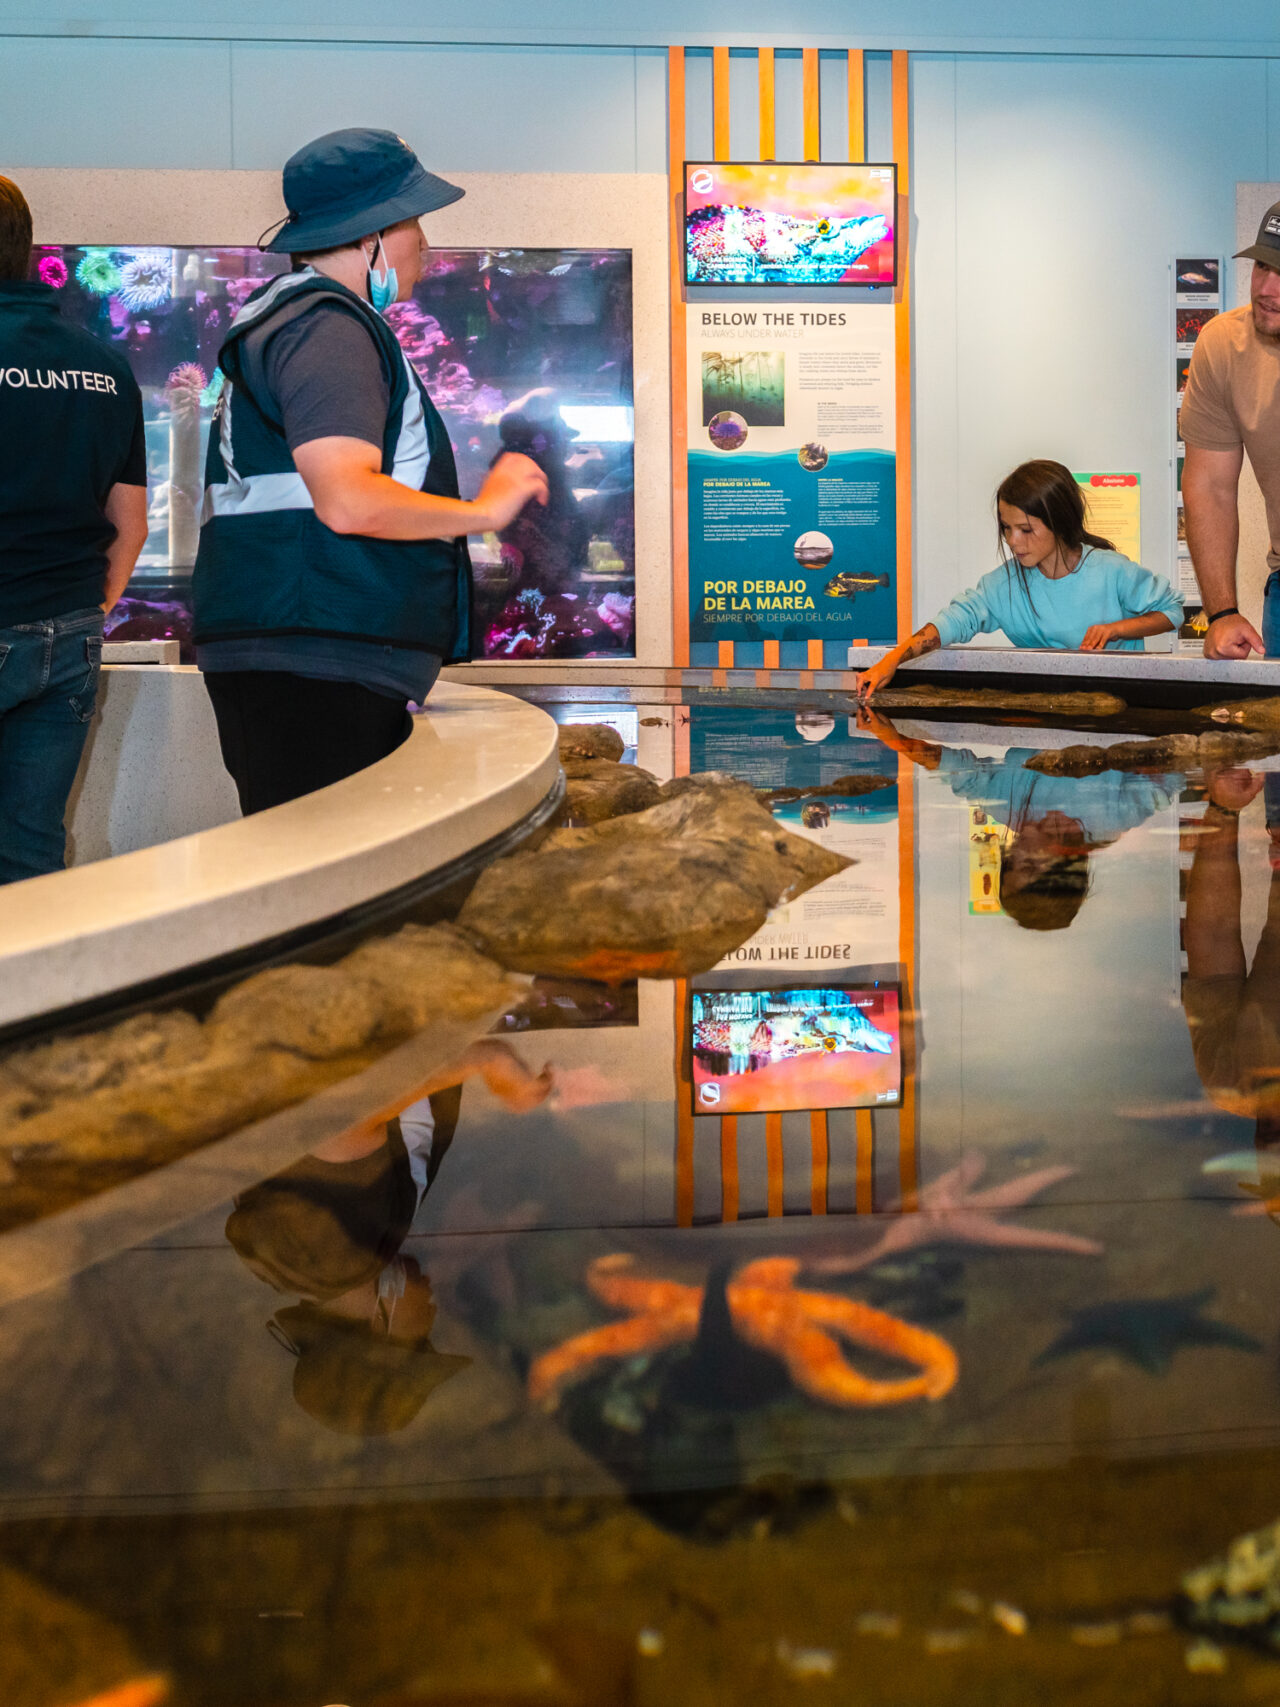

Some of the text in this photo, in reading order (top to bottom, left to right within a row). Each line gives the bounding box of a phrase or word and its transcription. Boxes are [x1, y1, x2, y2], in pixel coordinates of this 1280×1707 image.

[702, 313, 847, 326] BELOW THE TIDES
[700, 329, 804, 338] ALWAYS UNDER WATER
[704, 580, 807, 594] POR DEBAJO
[704, 596, 815, 611] DE LA MAREA
[703, 612, 852, 623] SIEMPRE POR DEBAJO DEL AGUA
